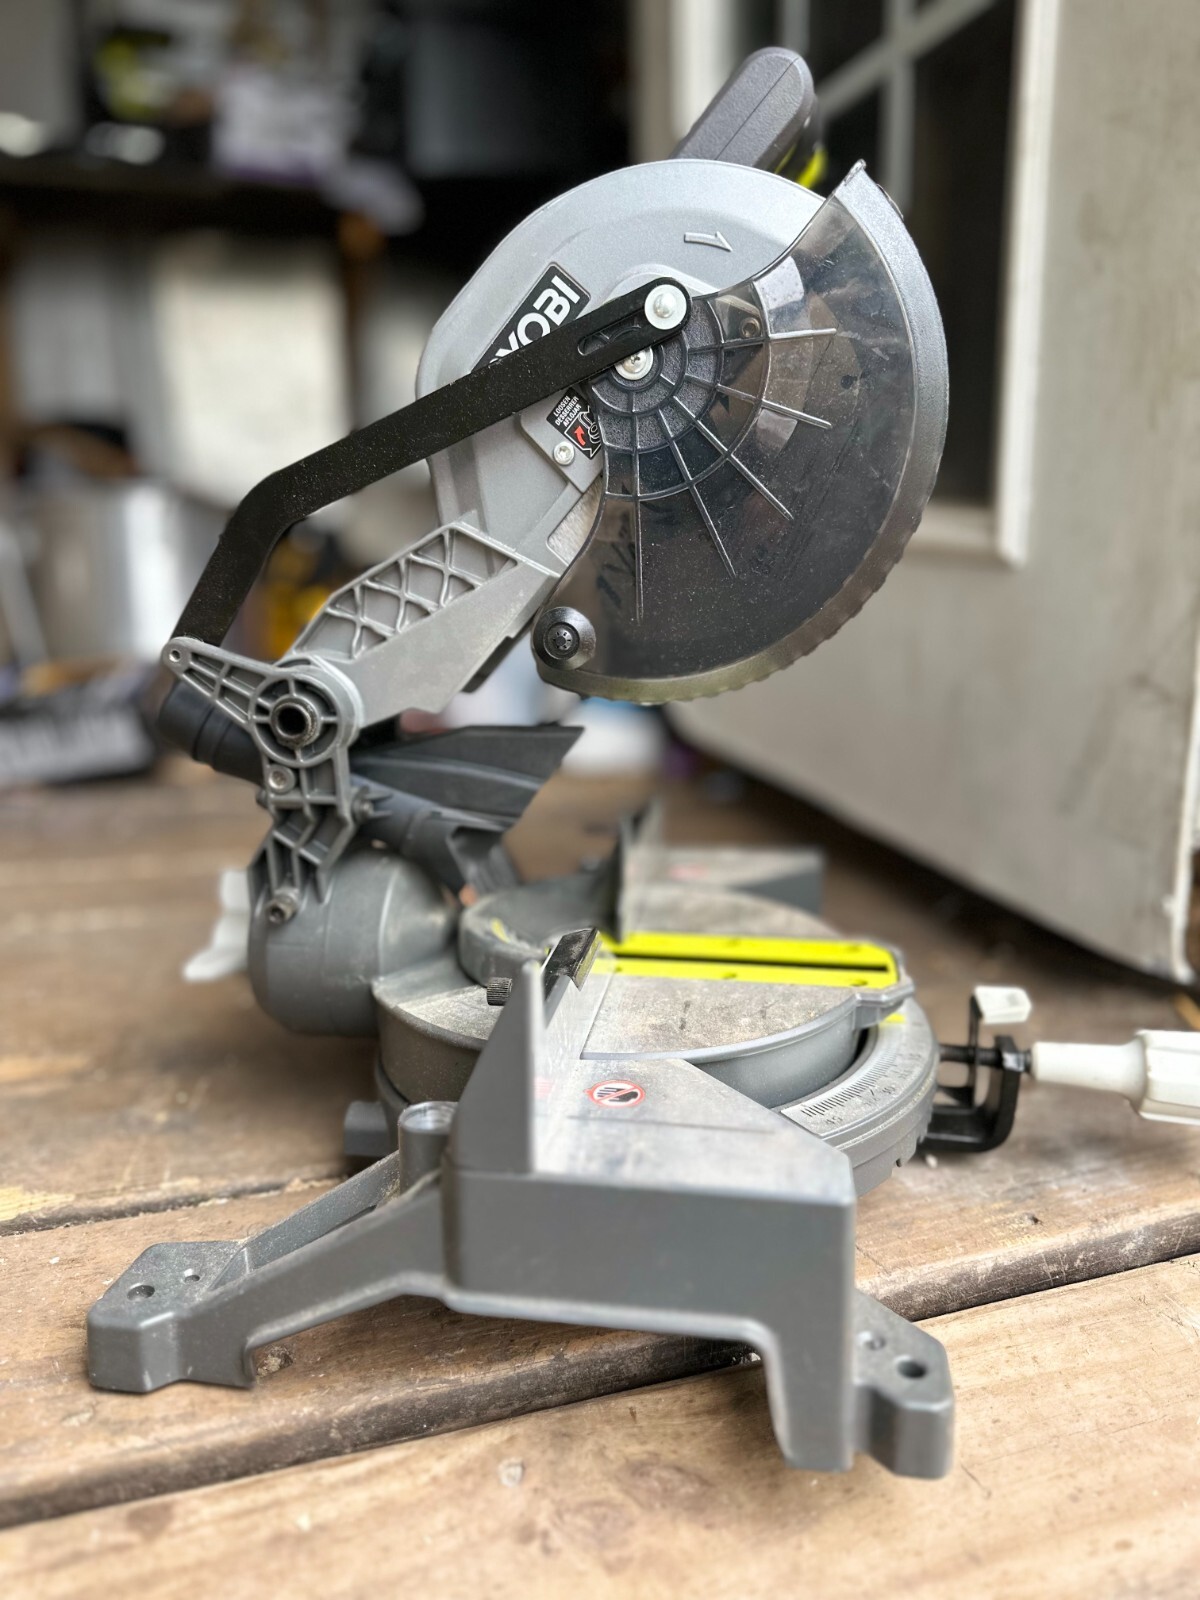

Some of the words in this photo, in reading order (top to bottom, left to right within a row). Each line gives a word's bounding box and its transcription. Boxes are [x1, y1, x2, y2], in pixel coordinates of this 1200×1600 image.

[489, 274, 581, 364] YOBI
[553, 395, 571, 417] LOOSEN
[555, 396, 579, 426] DESSERRER
[562, 403, 582, 427] AFLOJAR
